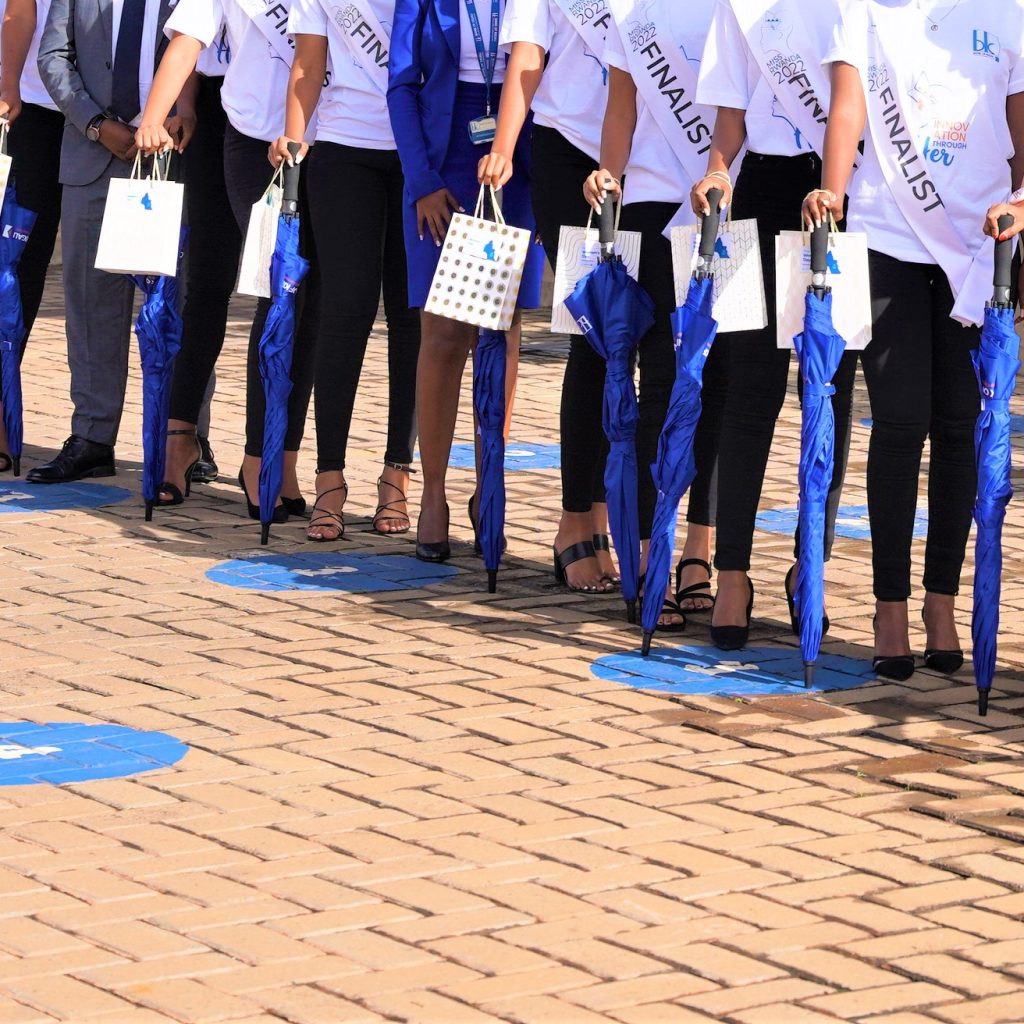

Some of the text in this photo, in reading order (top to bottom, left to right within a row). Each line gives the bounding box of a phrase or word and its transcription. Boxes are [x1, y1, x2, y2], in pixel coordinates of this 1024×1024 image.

[576, 0, 608, 26] 2022
[631, 26, 657, 52] 2022
[766, 54, 783, 68] MISS
[769, 54, 802, 75] RWANDA
[773, 60, 807, 85] 2022
[879, 86, 945, 213] FINALIST
[932, 140, 967, 150] THROUGH
